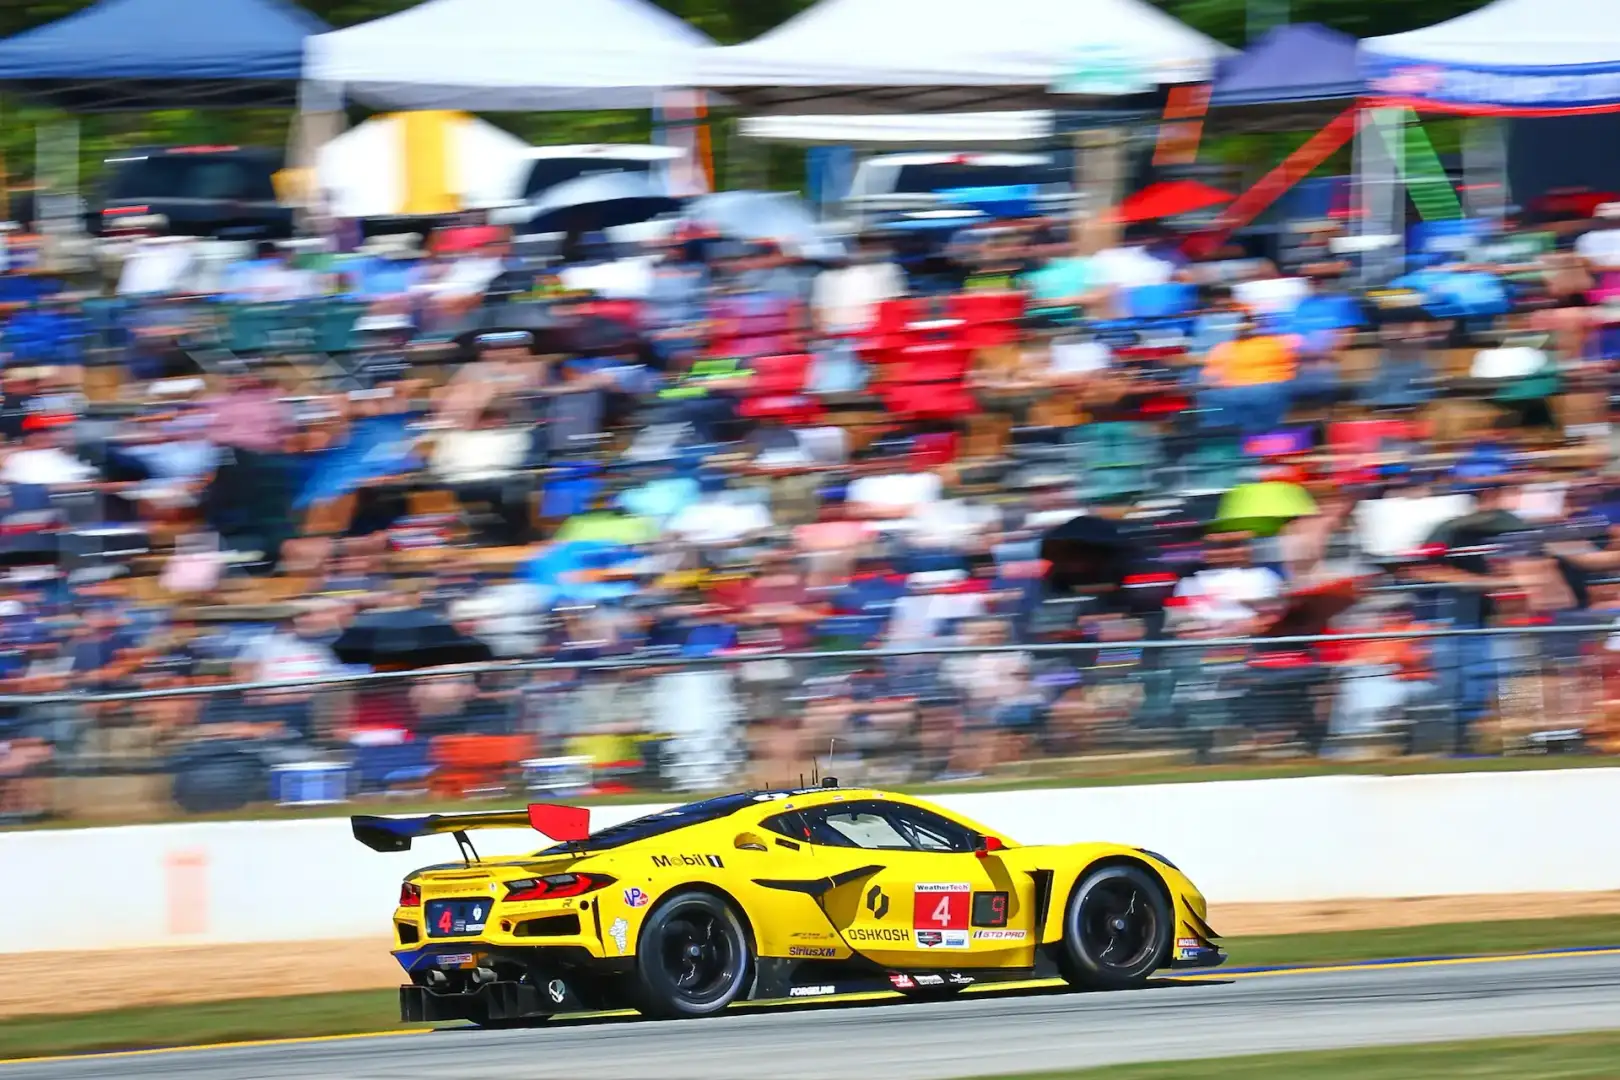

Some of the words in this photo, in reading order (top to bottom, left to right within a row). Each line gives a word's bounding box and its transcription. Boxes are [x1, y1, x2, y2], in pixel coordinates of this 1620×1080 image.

[651, 853, 705, 868] Mobil
[708, 854, 723, 868] 1
[931, 896, 951, 927] 4
[991, 896, 1005, 924] 9
[437, 909, 453, 934] 4
[848, 929, 910, 941] OSHKOSH
[1004, 930, 1025, 938] PRO
[788, 946, 836, 957] SiriusXM
